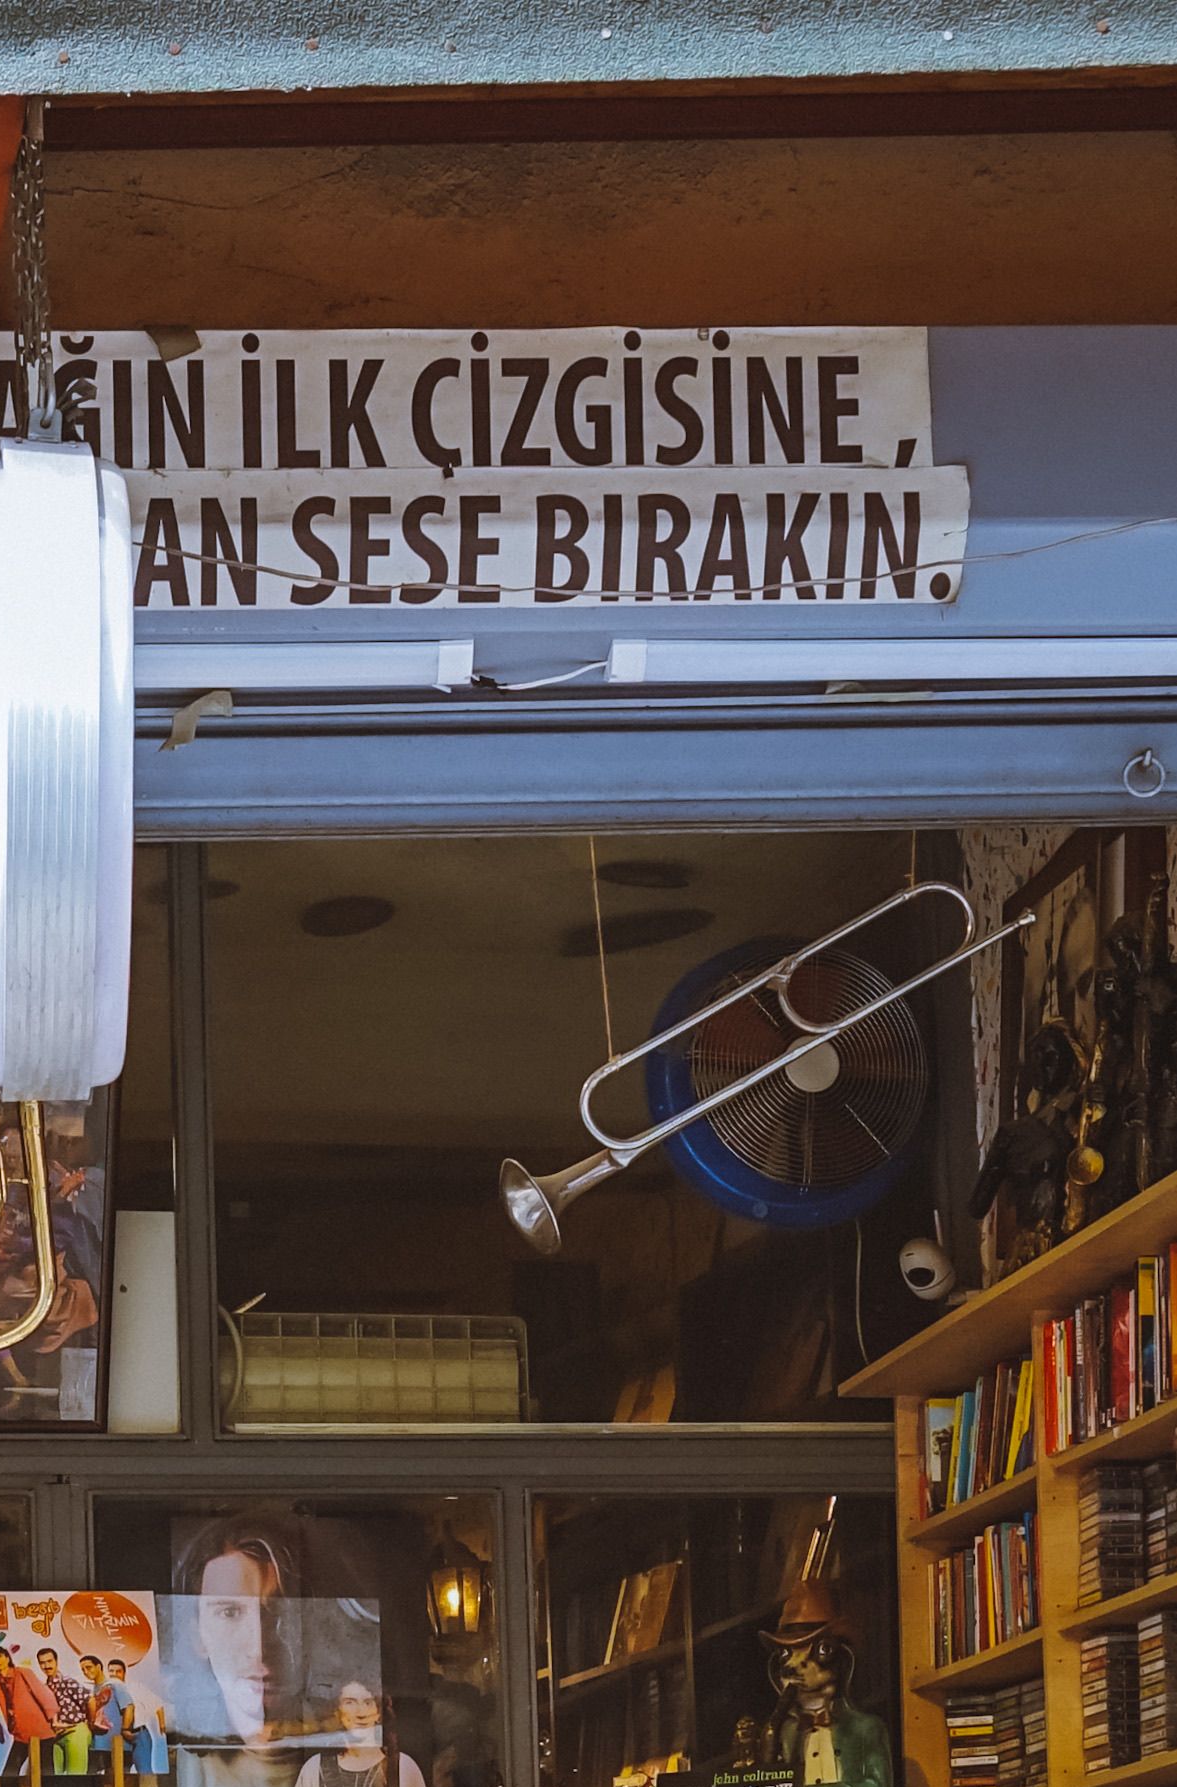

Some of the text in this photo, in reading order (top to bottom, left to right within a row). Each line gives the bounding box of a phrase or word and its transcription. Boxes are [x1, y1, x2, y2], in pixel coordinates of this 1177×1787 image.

[242, 333, 386, 468] İLK
[289, 493, 501, 604] SESE
[535, 490, 951, 602] BIRAKIN.
[12, 1597, 61, 1620] best
[31, 1614, 55, 1639] of
[711, 1768, 794, 1787] john coltrane
